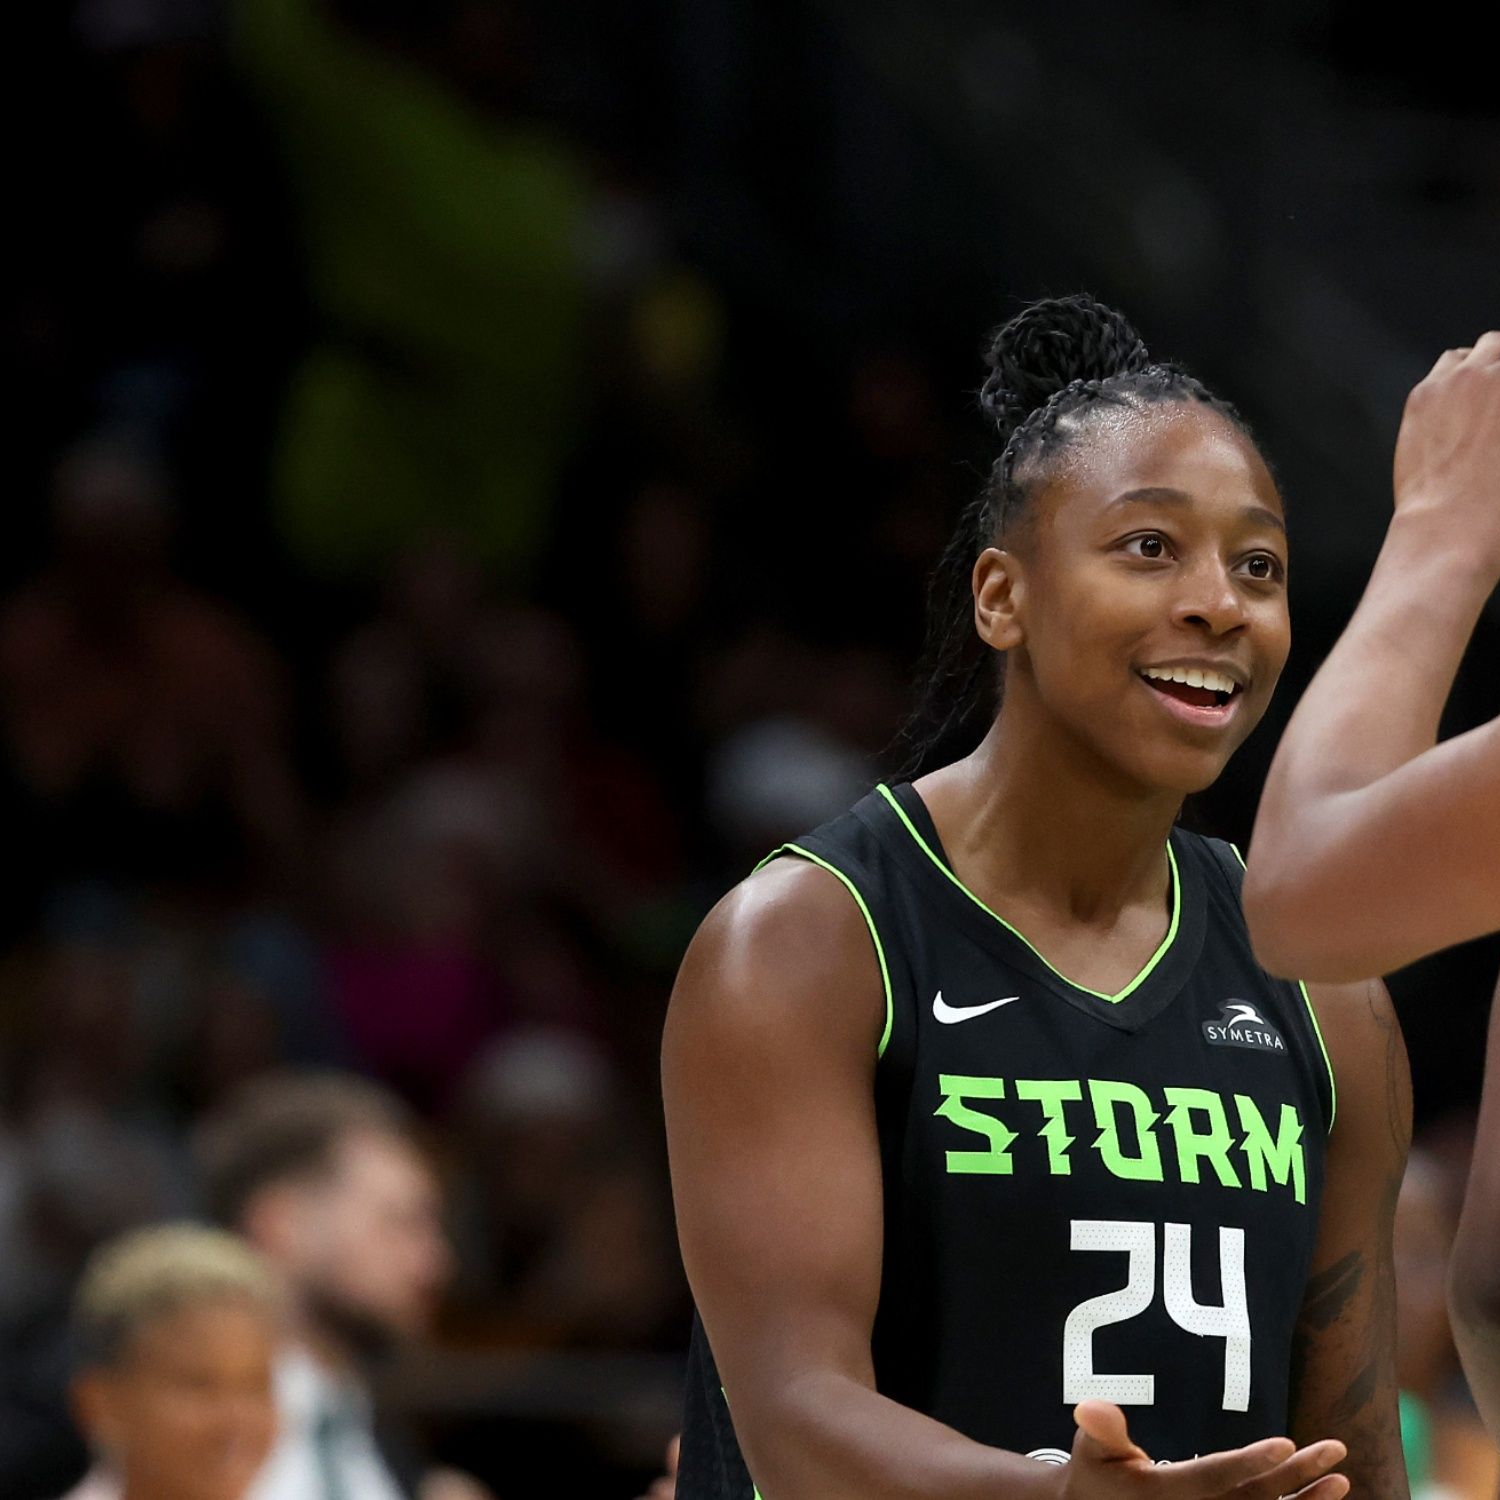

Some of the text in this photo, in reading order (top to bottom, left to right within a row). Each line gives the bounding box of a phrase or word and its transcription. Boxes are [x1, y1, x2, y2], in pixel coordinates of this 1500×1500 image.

[1207, 1026, 1284, 1050] SYMETRA
[933, 1074, 1306, 1205] STORM
[1063, 1219, 1251, 1412] 24
